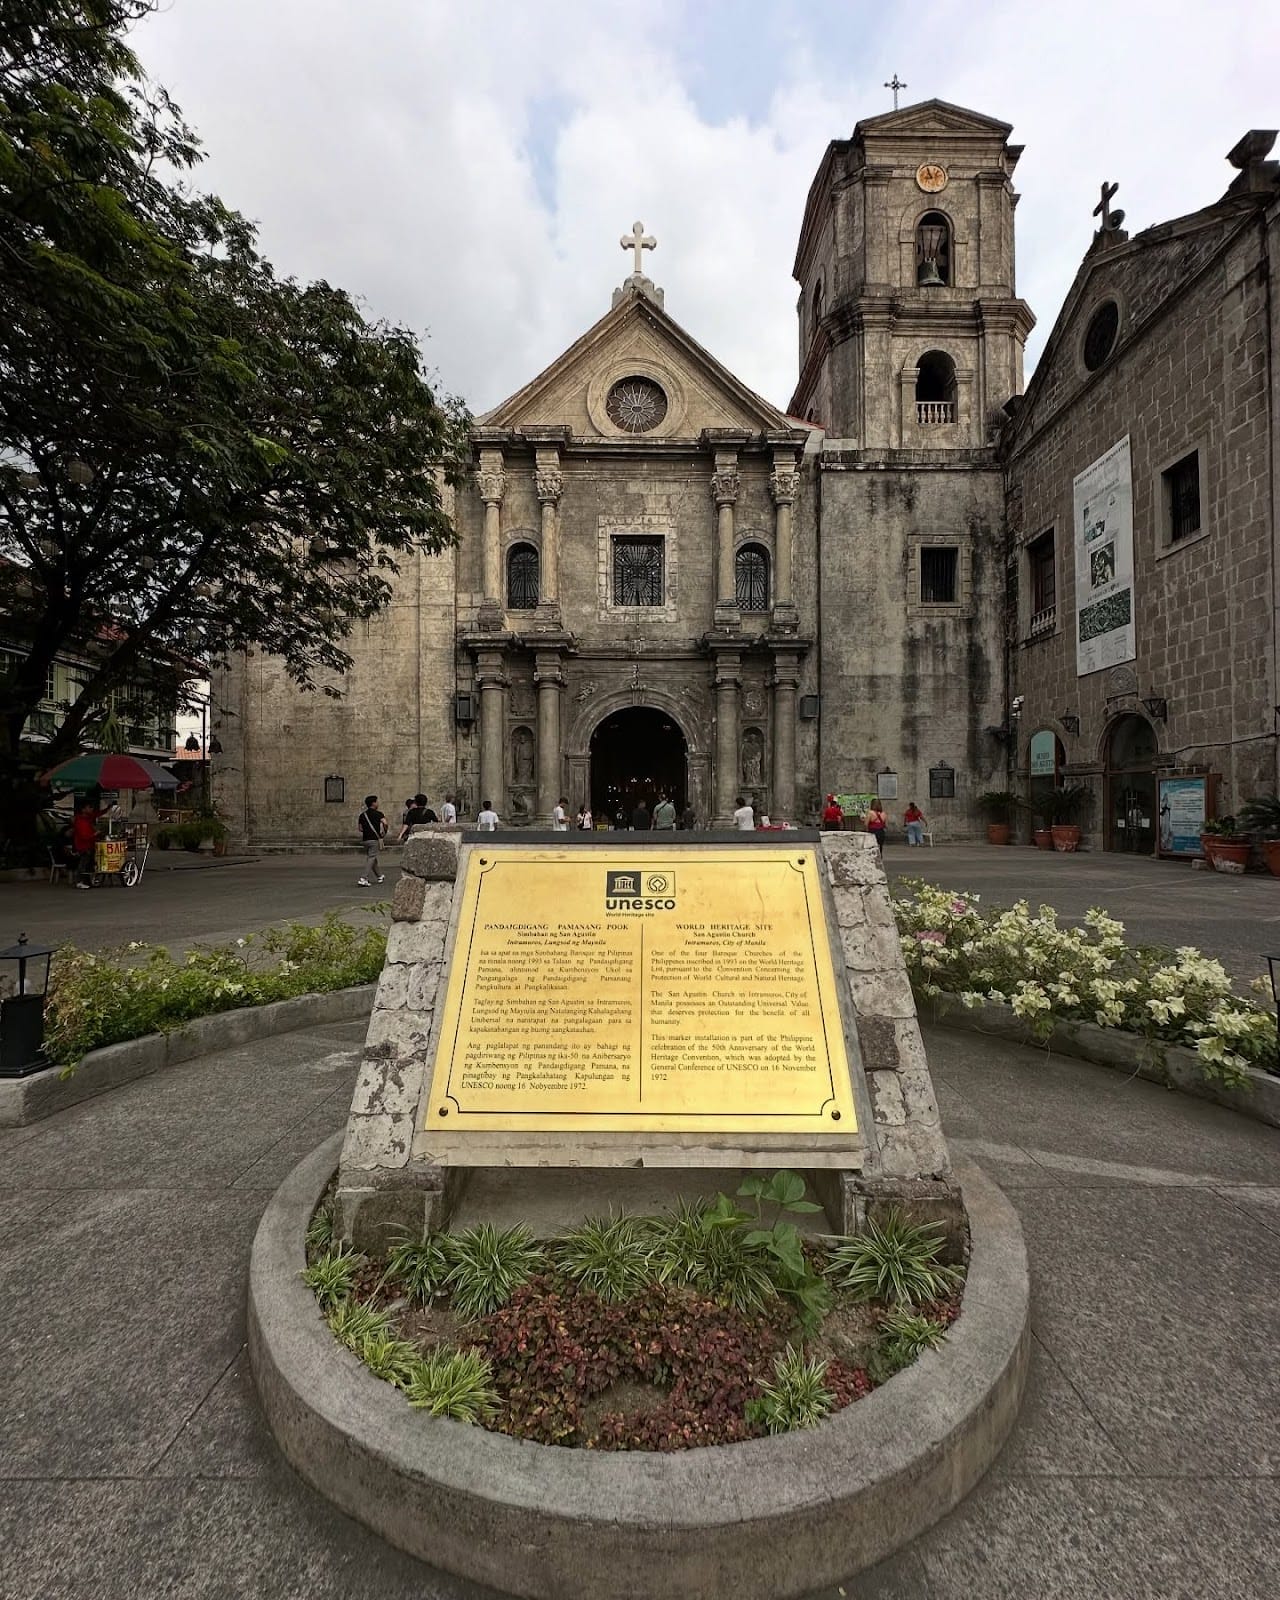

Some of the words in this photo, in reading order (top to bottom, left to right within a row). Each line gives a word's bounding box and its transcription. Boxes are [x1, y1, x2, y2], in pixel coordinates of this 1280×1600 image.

[606, 899, 675, 910] unesco
[706, 931, 730, 939] Agustin
[722, 939, 734, 947] City
[461, 1081, 494, 1090] UNESCO
[529, 1081, 568, 1091] Nobyembre
